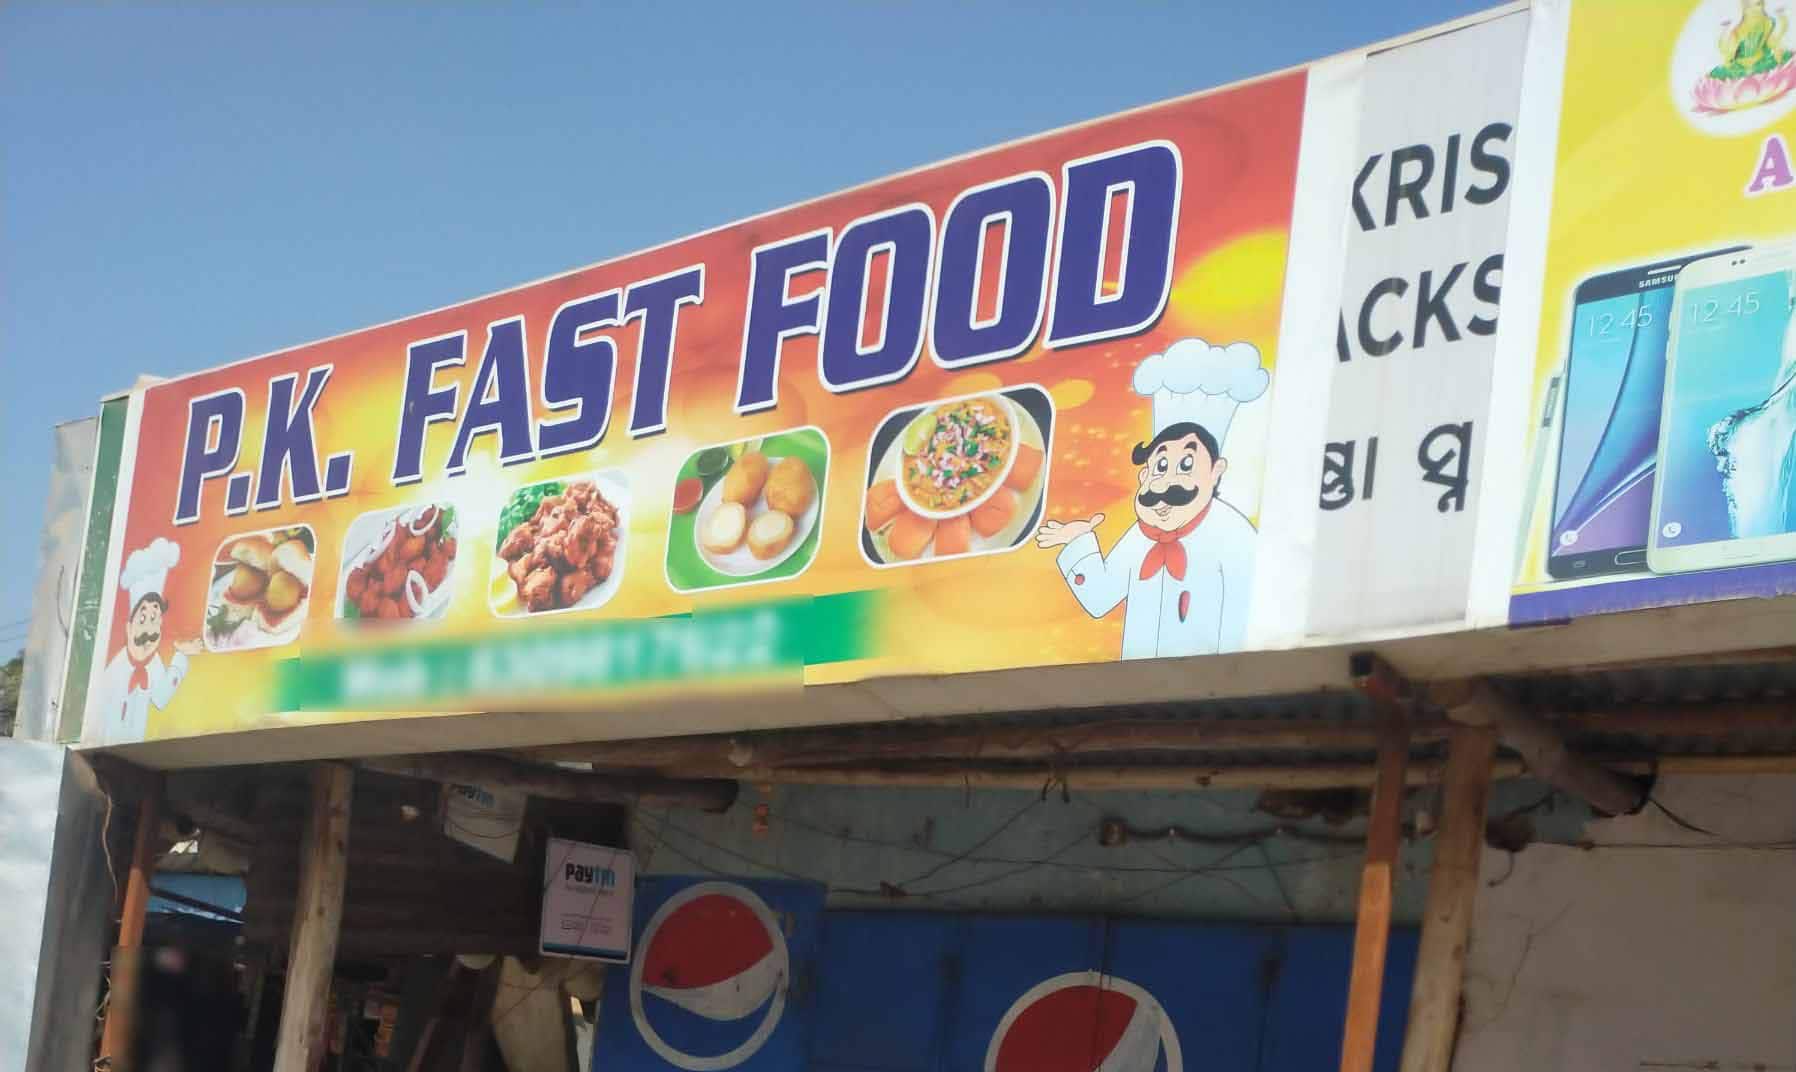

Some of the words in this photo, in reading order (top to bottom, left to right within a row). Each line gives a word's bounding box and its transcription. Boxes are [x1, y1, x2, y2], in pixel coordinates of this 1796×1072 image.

[174, 364, 353, 524] P.K.
[392, 263, 705, 485] FAST
[735, 139, 1183, 415] FOOD
[1336, 253, 1504, 362] CKS
[1639, 273, 1678, 288] SAMSU
